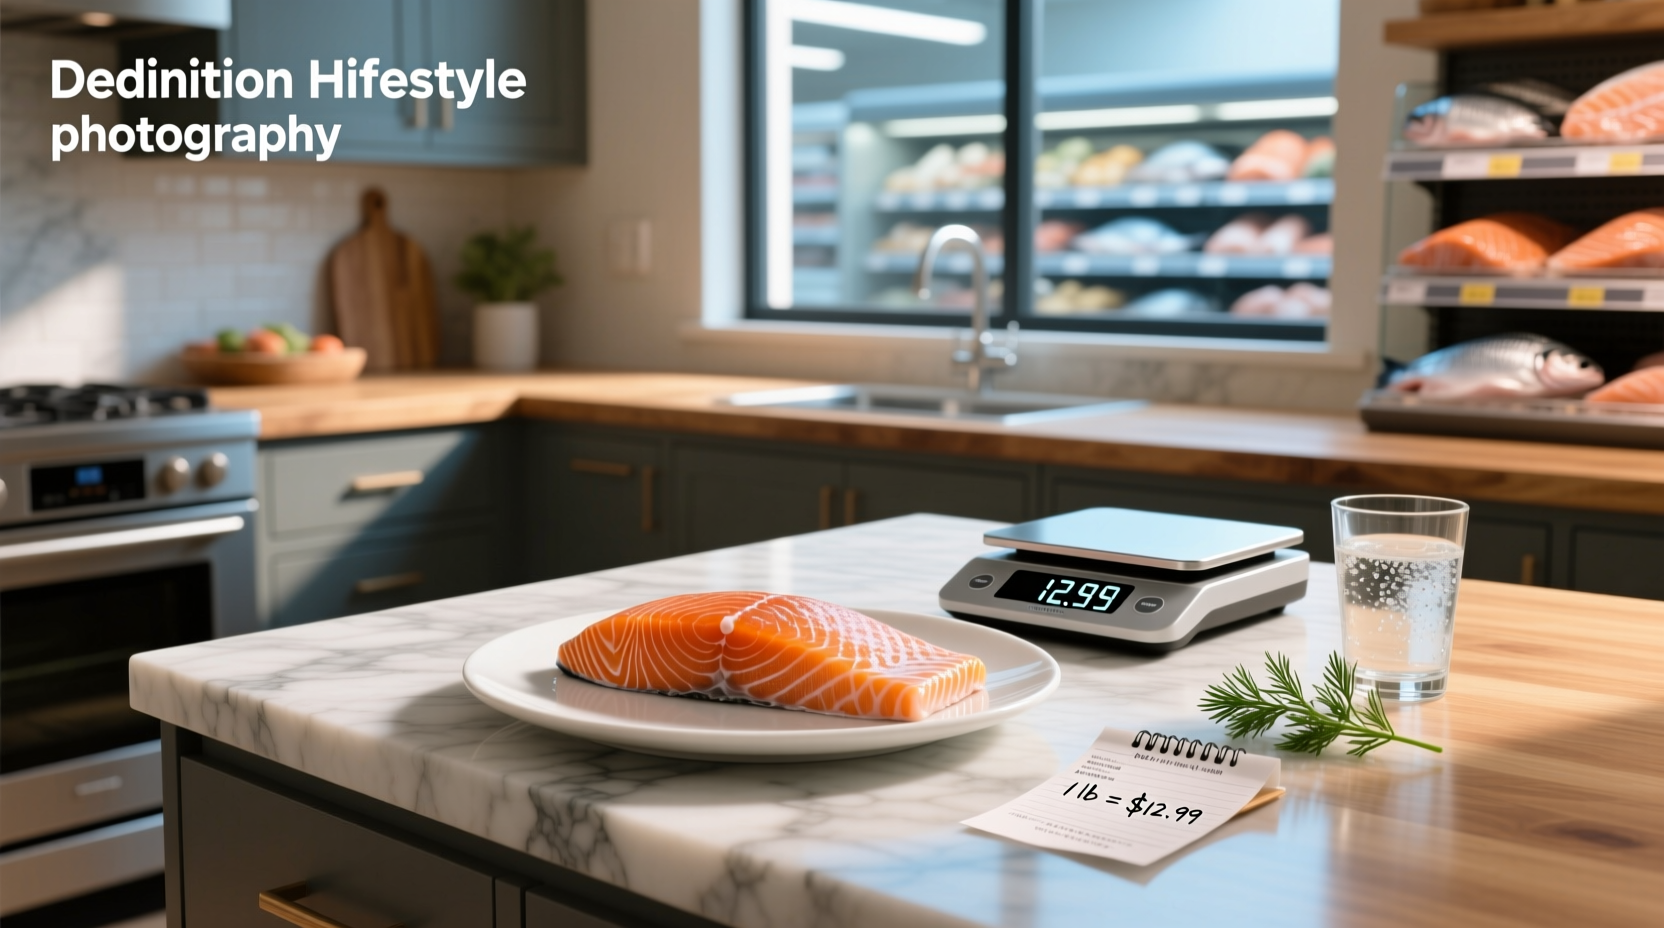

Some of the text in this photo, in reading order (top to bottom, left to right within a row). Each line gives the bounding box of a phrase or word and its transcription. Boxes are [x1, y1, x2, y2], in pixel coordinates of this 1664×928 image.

[1037, 578, 1121, 611] 12.99
[1076, 782, 1098, 801] lb
[1125, 792, 1203, 825] $12.99
